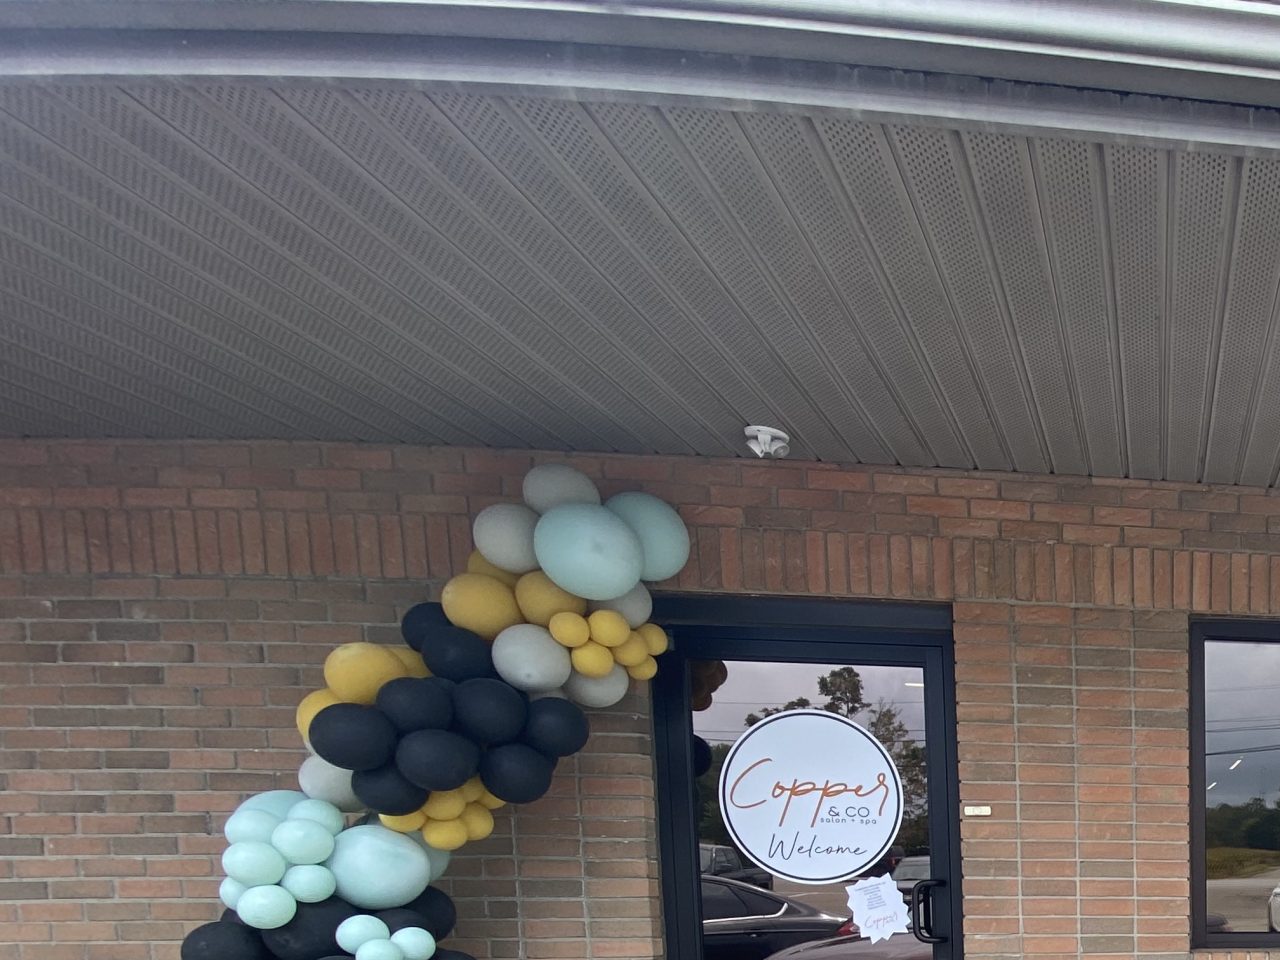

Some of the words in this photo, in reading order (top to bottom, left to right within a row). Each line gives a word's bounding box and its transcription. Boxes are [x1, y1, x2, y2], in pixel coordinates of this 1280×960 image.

[731, 758, 889, 827] Copper
[828, 806, 840, 817] &
[845, 806, 870, 818] CO
[769, 832, 867, 861] Welcome
